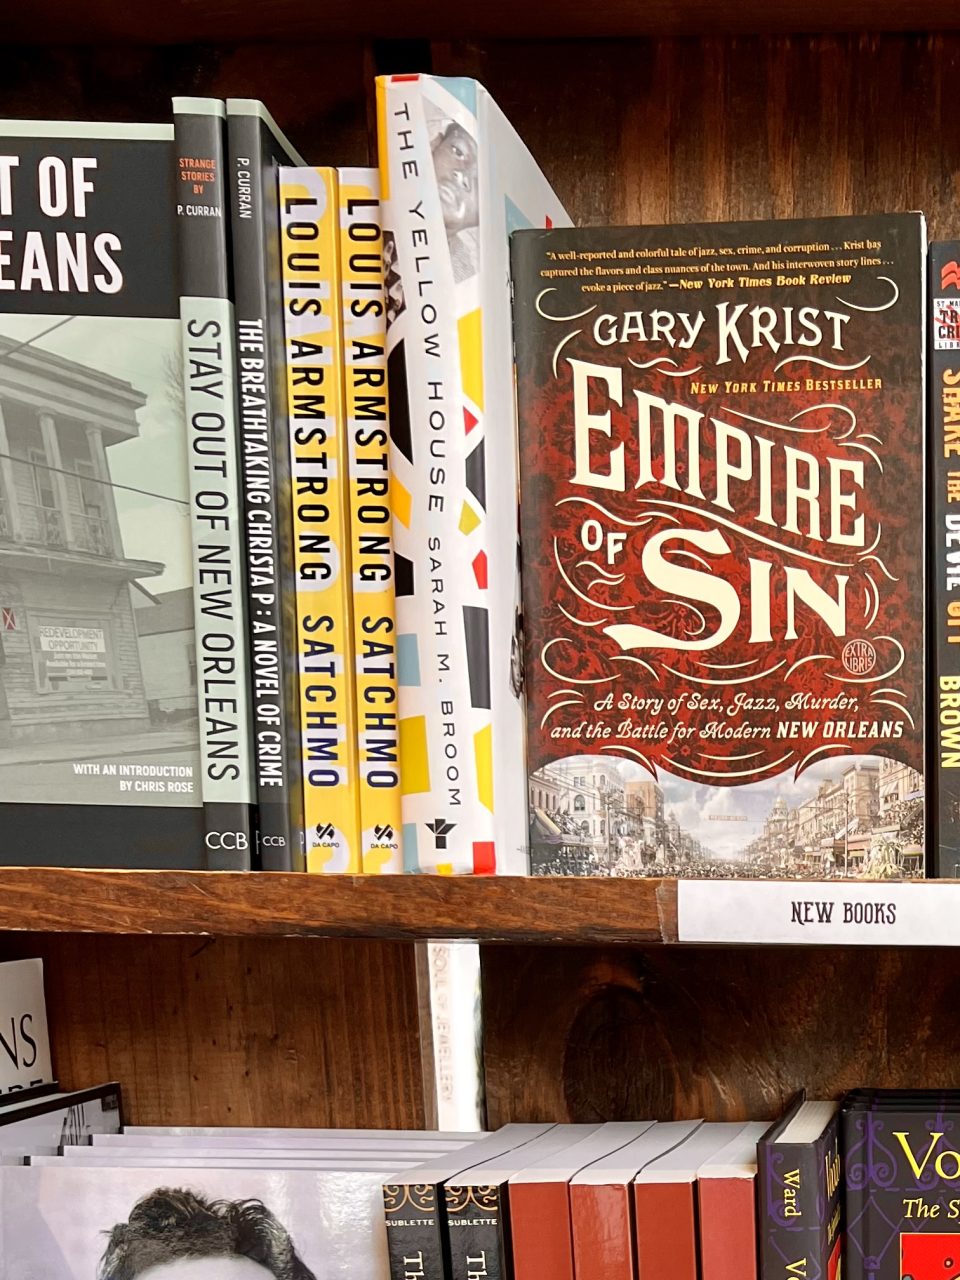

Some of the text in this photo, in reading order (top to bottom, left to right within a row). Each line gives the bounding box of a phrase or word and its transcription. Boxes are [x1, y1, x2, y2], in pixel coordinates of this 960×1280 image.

[179, 158, 216, 169] STRANGE
[39, 156, 98, 218] OF
[181, 171, 215, 182] STORIES
[194, 184, 204, 194] BY
[593, 302, 850, 364] GARY KRIST
[691, 379, 882, 394] NEW YORK TIMES BESTSELLER
[394, 102, 461, 806] THE YELLOW HOUSE SARAH M. BROOM
[568, 358, 864, 546] EMPIRE
[286, 198, 339, 787] LOUIS ARMSTRONG SATCHMO
[188, 319, 240, 781] STAY OUT OF NEW ORLEANS
[581, 520, 627, 564] OF
[603, 528, 850, 651] SIN
[594, 693, 859, 715] A Story of Sex, Jazz, Murder,
[551, 720, 903, 743] and the Battle for Modern NEW ORLEANS
[73, 764, 193, 777] WITH AN INTRODUCTION
[120, 781, 193, 792] BY CHRIS ROSE
[791, 901, 896, 926] NEW BOOKS
[903, 1199, 939, 1220] The
